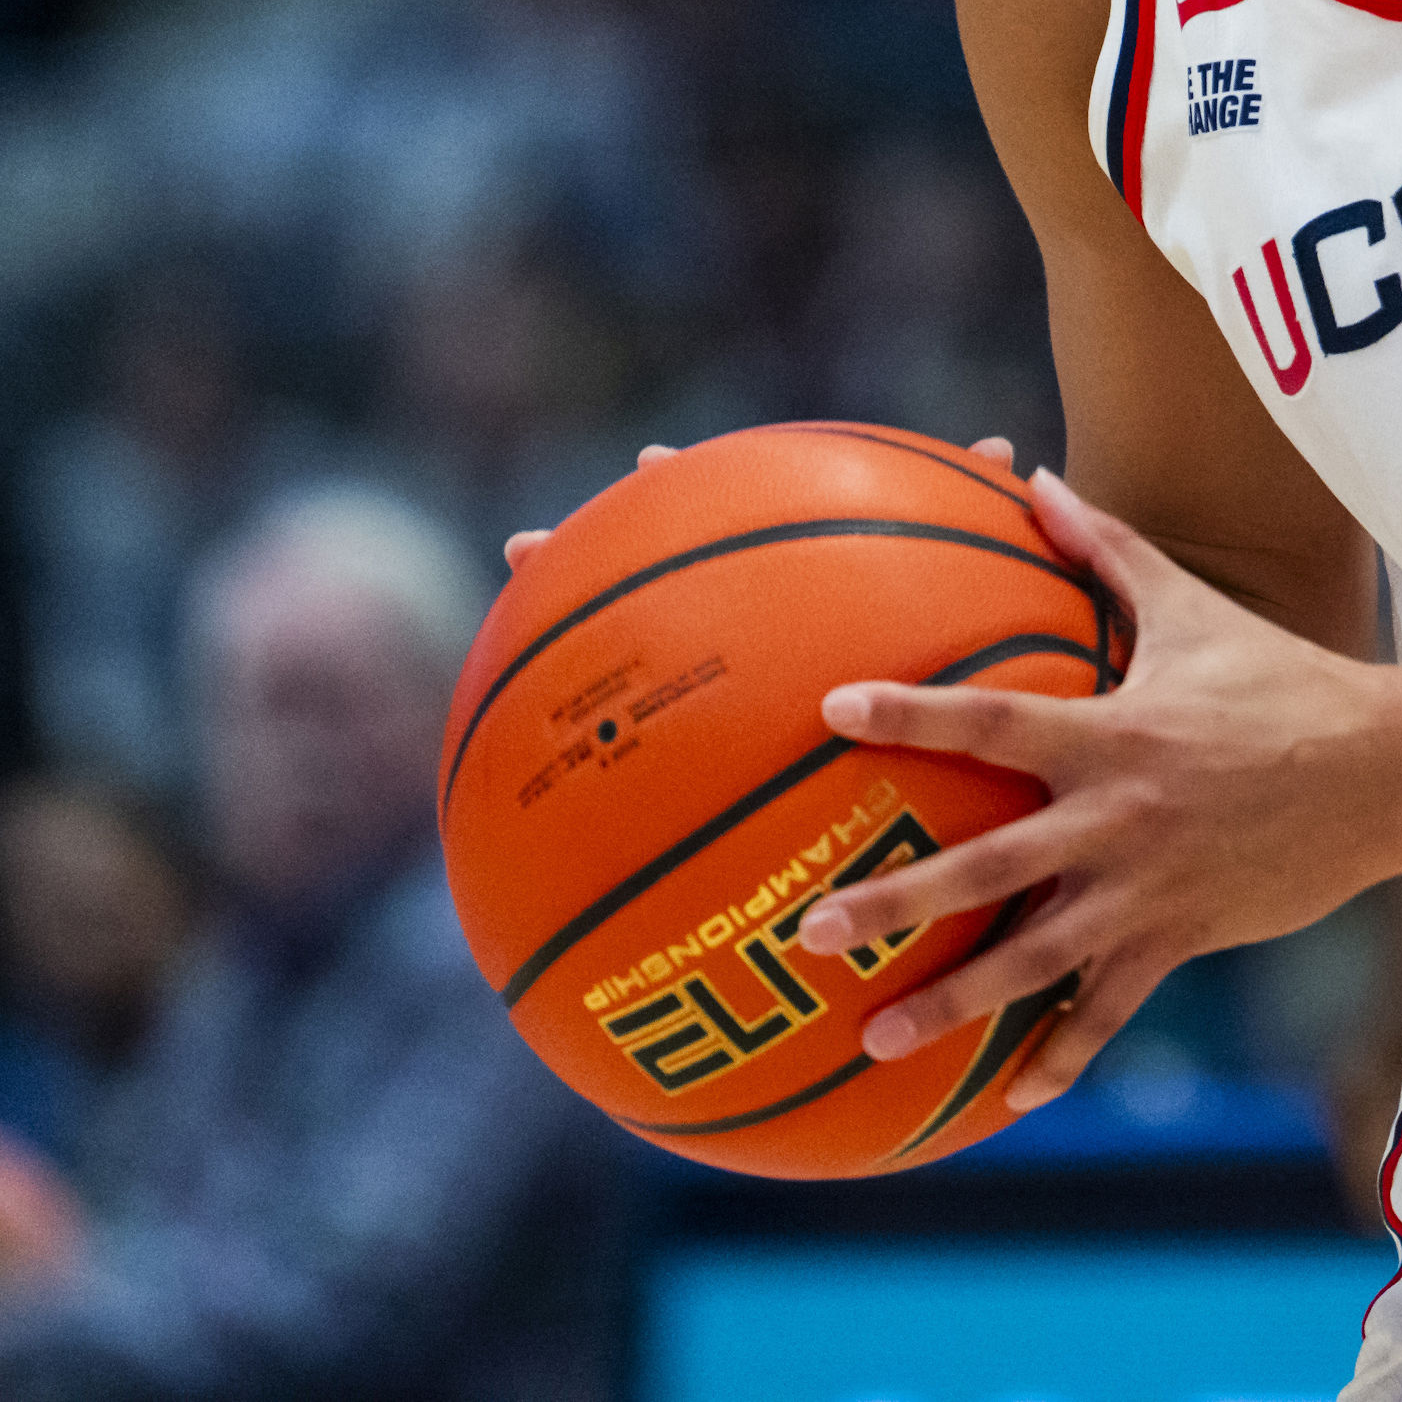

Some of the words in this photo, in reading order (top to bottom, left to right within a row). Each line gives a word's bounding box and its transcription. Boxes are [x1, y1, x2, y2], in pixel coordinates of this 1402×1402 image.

[1197, 59, 1257, 97] THE
[1188, 93, 1263, 137] ANGE
[583, 779, 899, 1014] CHAMPIONSHIP
